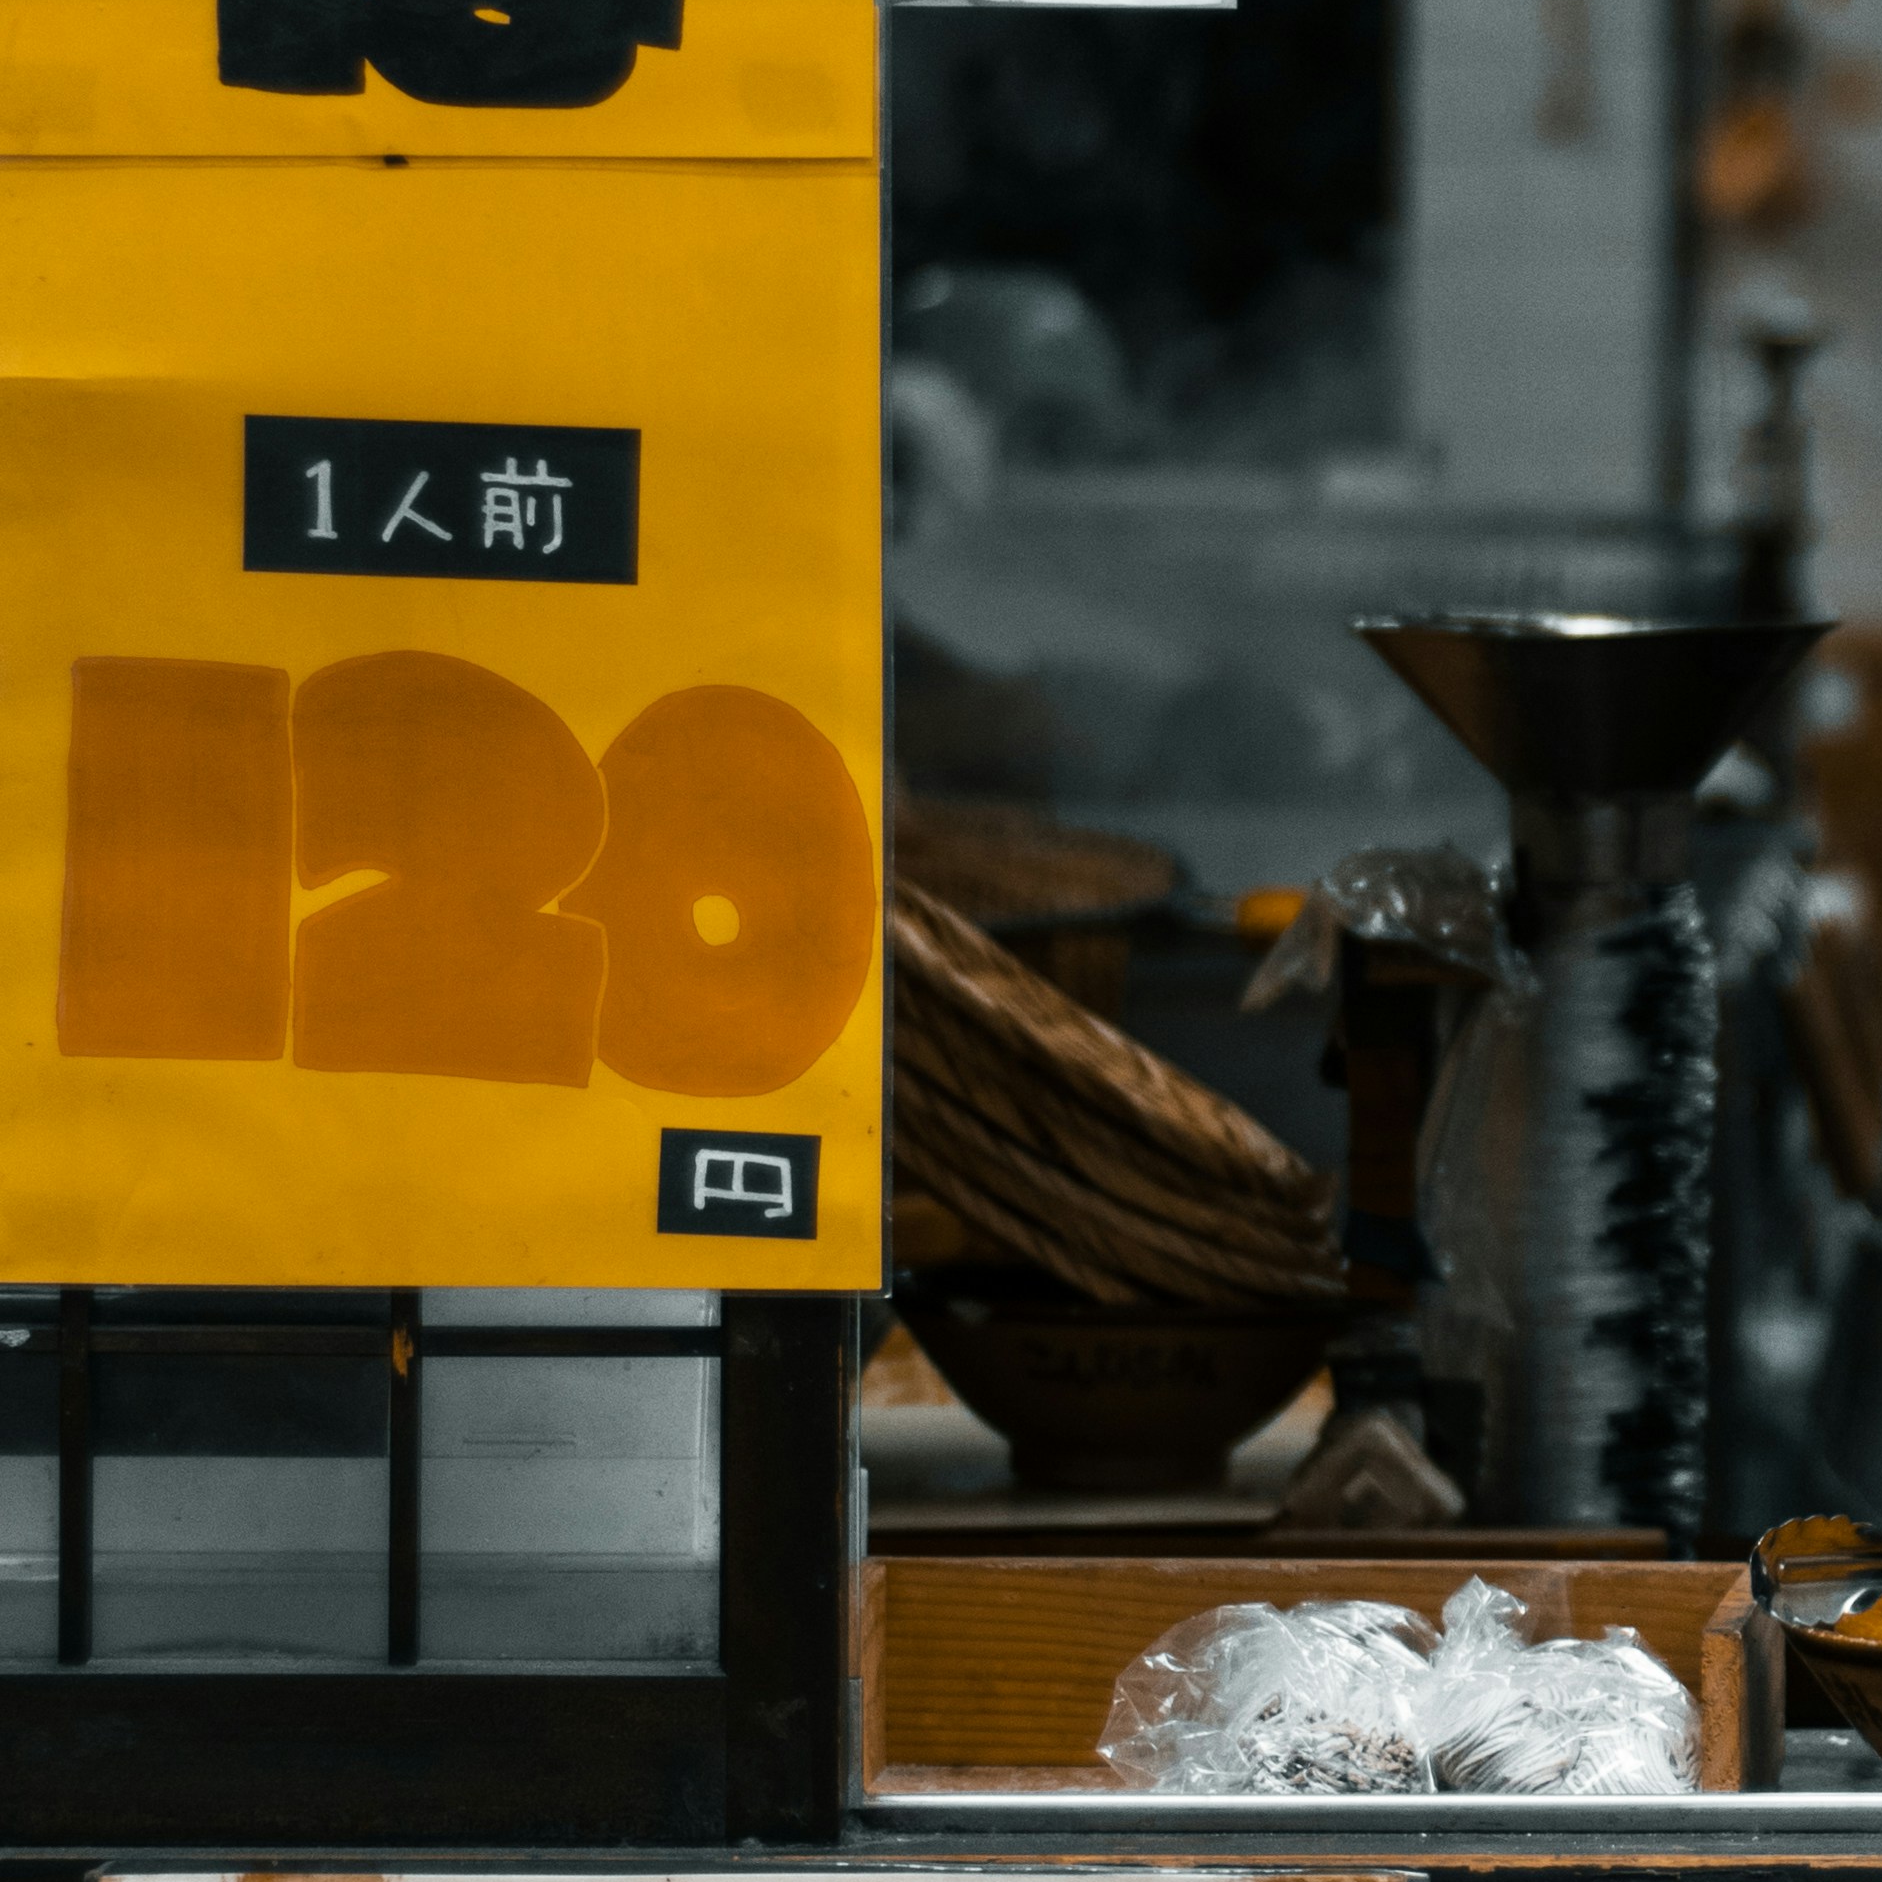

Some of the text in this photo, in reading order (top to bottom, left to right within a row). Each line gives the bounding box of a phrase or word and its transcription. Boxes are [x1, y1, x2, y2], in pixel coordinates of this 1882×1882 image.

[305, 457, 573, 555] 1人前
[56, 650, 876, 1098] 120
[694, 1148, 793, 1219] 円
